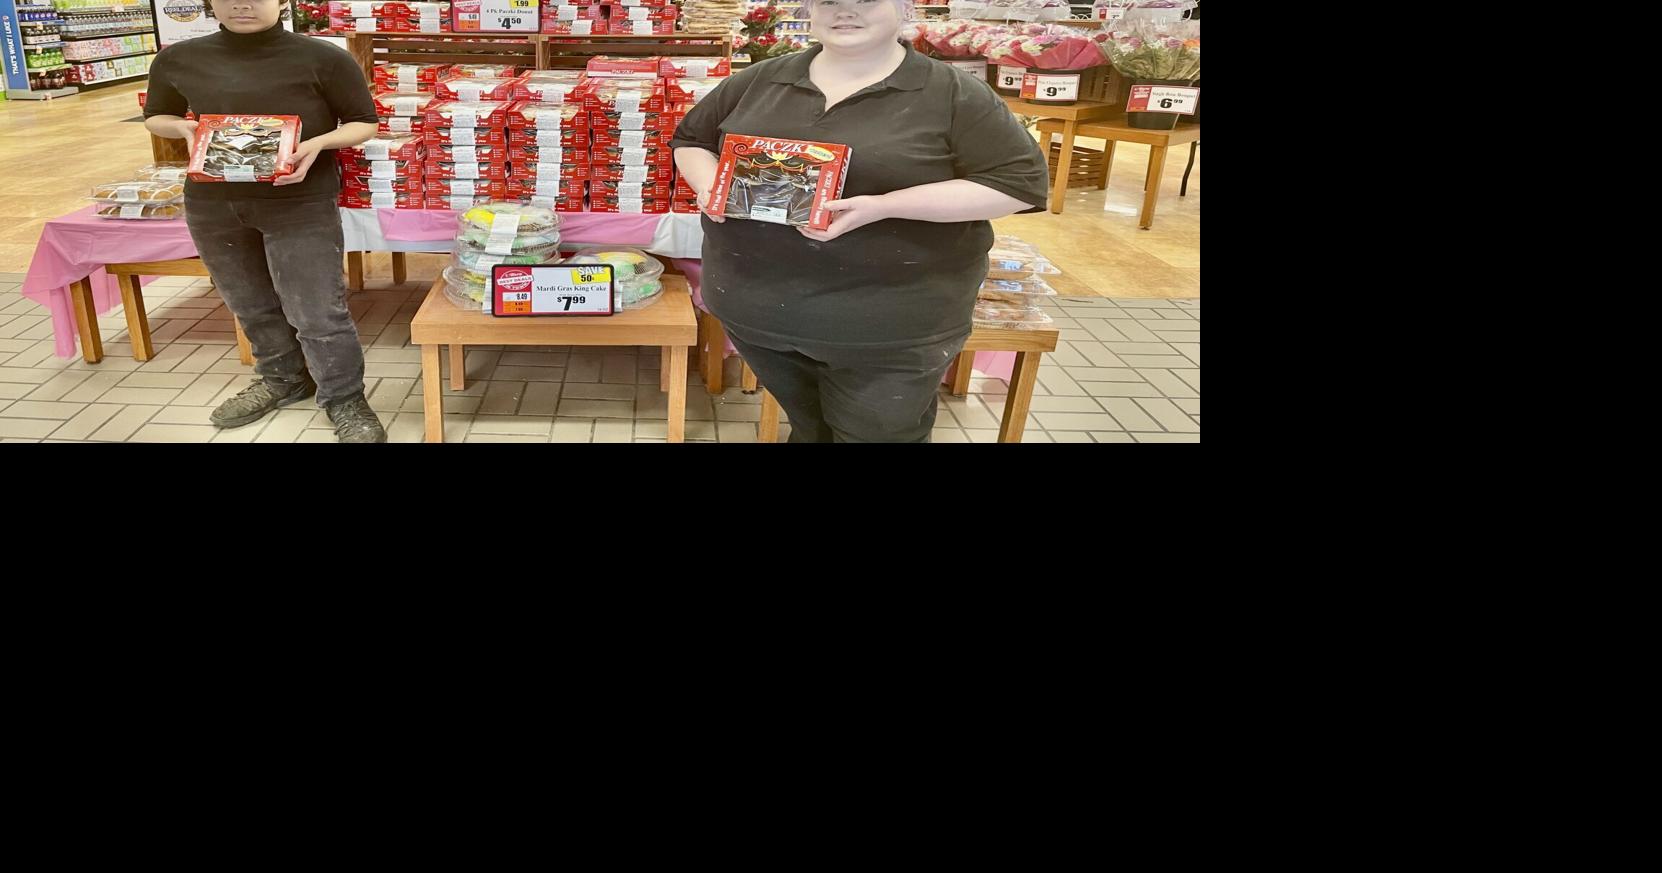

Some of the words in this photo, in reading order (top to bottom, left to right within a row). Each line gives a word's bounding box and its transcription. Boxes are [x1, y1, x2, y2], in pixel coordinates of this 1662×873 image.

[4, 21, 12, 34] LIKE
[7, 38, 15, 55] WHAT
[10, 55, 19, 75] THAT'S
[577, 266, 606, 275] SAVE
[574, 285, 590, 293] King
